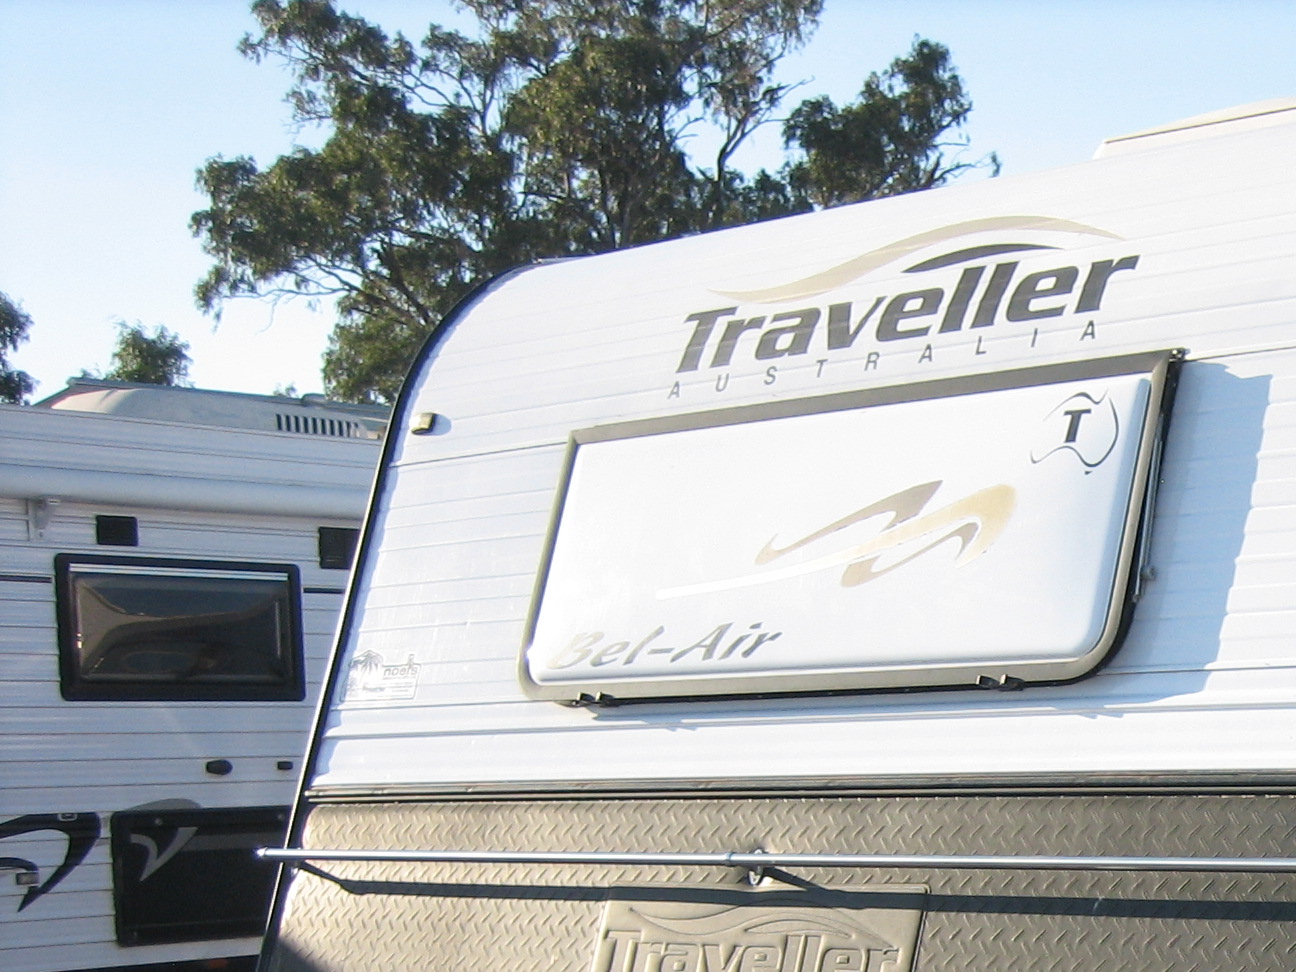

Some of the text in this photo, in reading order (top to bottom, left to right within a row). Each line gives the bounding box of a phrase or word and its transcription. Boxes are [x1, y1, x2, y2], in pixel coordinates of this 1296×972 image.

[675, 254, 1141, 374] Traveller
[667, 320, 1097, 399] AUSTRALIA
[1063, 408, 1092, 444] T
[546, 621, 783, 670] Bel-Air
